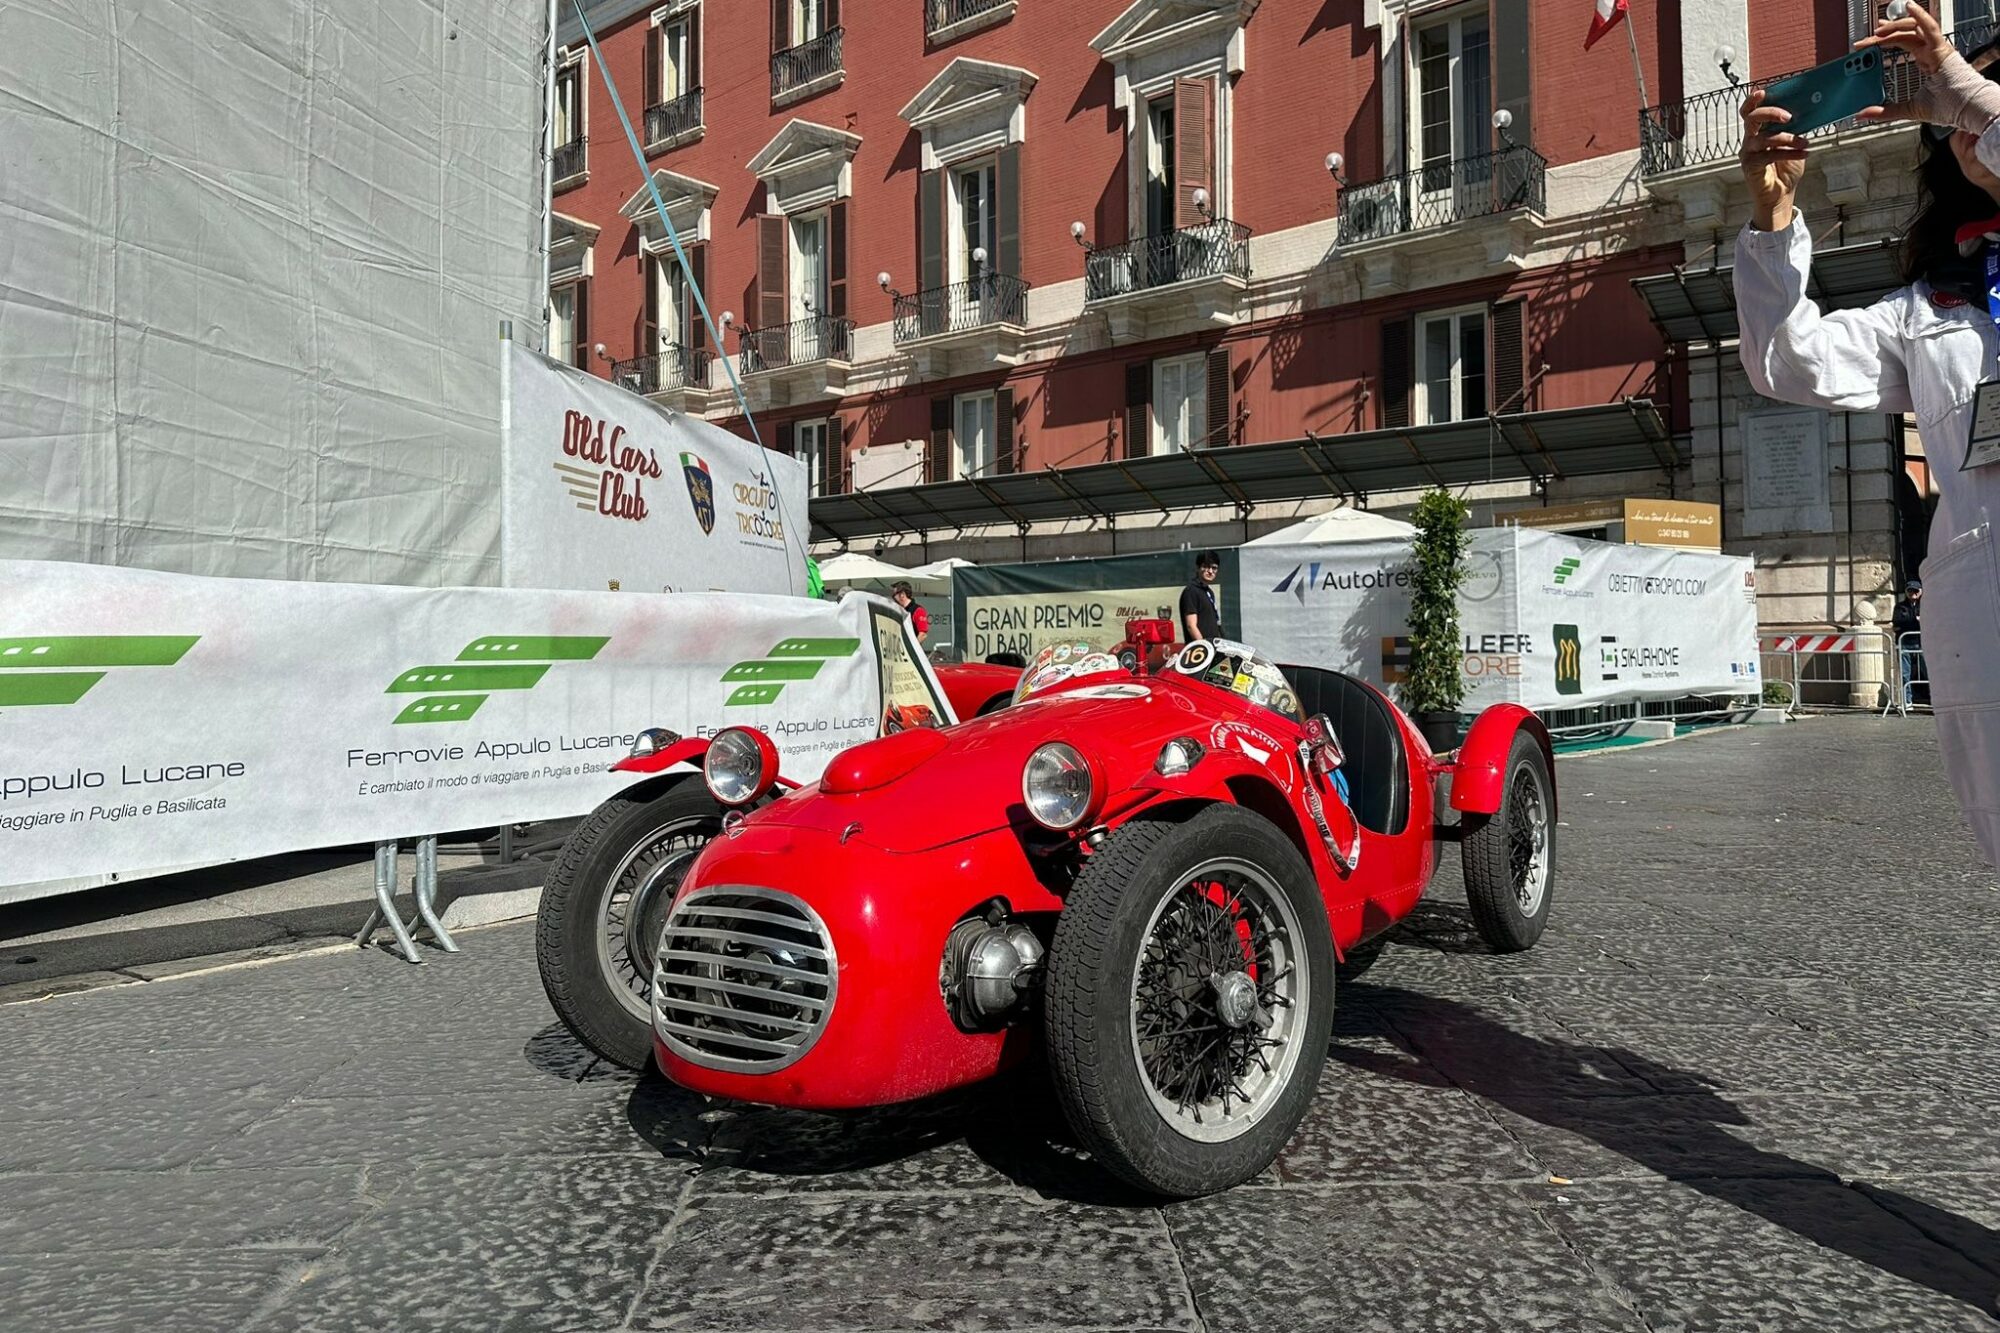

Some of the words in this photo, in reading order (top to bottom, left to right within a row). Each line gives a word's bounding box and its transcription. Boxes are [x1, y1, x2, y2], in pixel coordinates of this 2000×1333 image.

[563, 410, 607, 464] Old
[610, 425, 662, 478] Cars
[599, 470, 649, 521] Club
[733, 482, 776, 510] CIRCUITO
[736, 511, 783, 541] TRICOLORE
[1322, 569, 1416, 591] Autotre
[974, 606, 1027, 630] GRAN
[1034, 603, 1104, 629] PREMIO
[975, 634, 989, 656] DI
[997, 633, 1032, 656] BARI
[1184, 646, 1205, 665] 16
[775, 718, 828, 736] Appulo
[348, 743, 464, 767] Ferrovie
[474, 738, 551, 761] Appulo
[560, 733, 635, 752] Lucane
[0, 768, 105, 800] ppulo
[122, 762, 245, 785] Lucane
[370, 778, 425, 794] cambiato
[427, 777, 434, 788] il
[435, 774, 468, 788] modo
[471, 773, 481, 784] di
[484, 769, 529, 786] viaggiare
[531, 768, 541, 779] in
[543, 765, 572, 780] Puglia
[574, 766, 580, 774] e
[0, 811, 65, 831] iaggiare
[70, 808, 84, 822] in
[89, 804, 137, 823] Puglia
[142, 805, 152, 815] e
[156, 797, 227, 815] Basilicata
